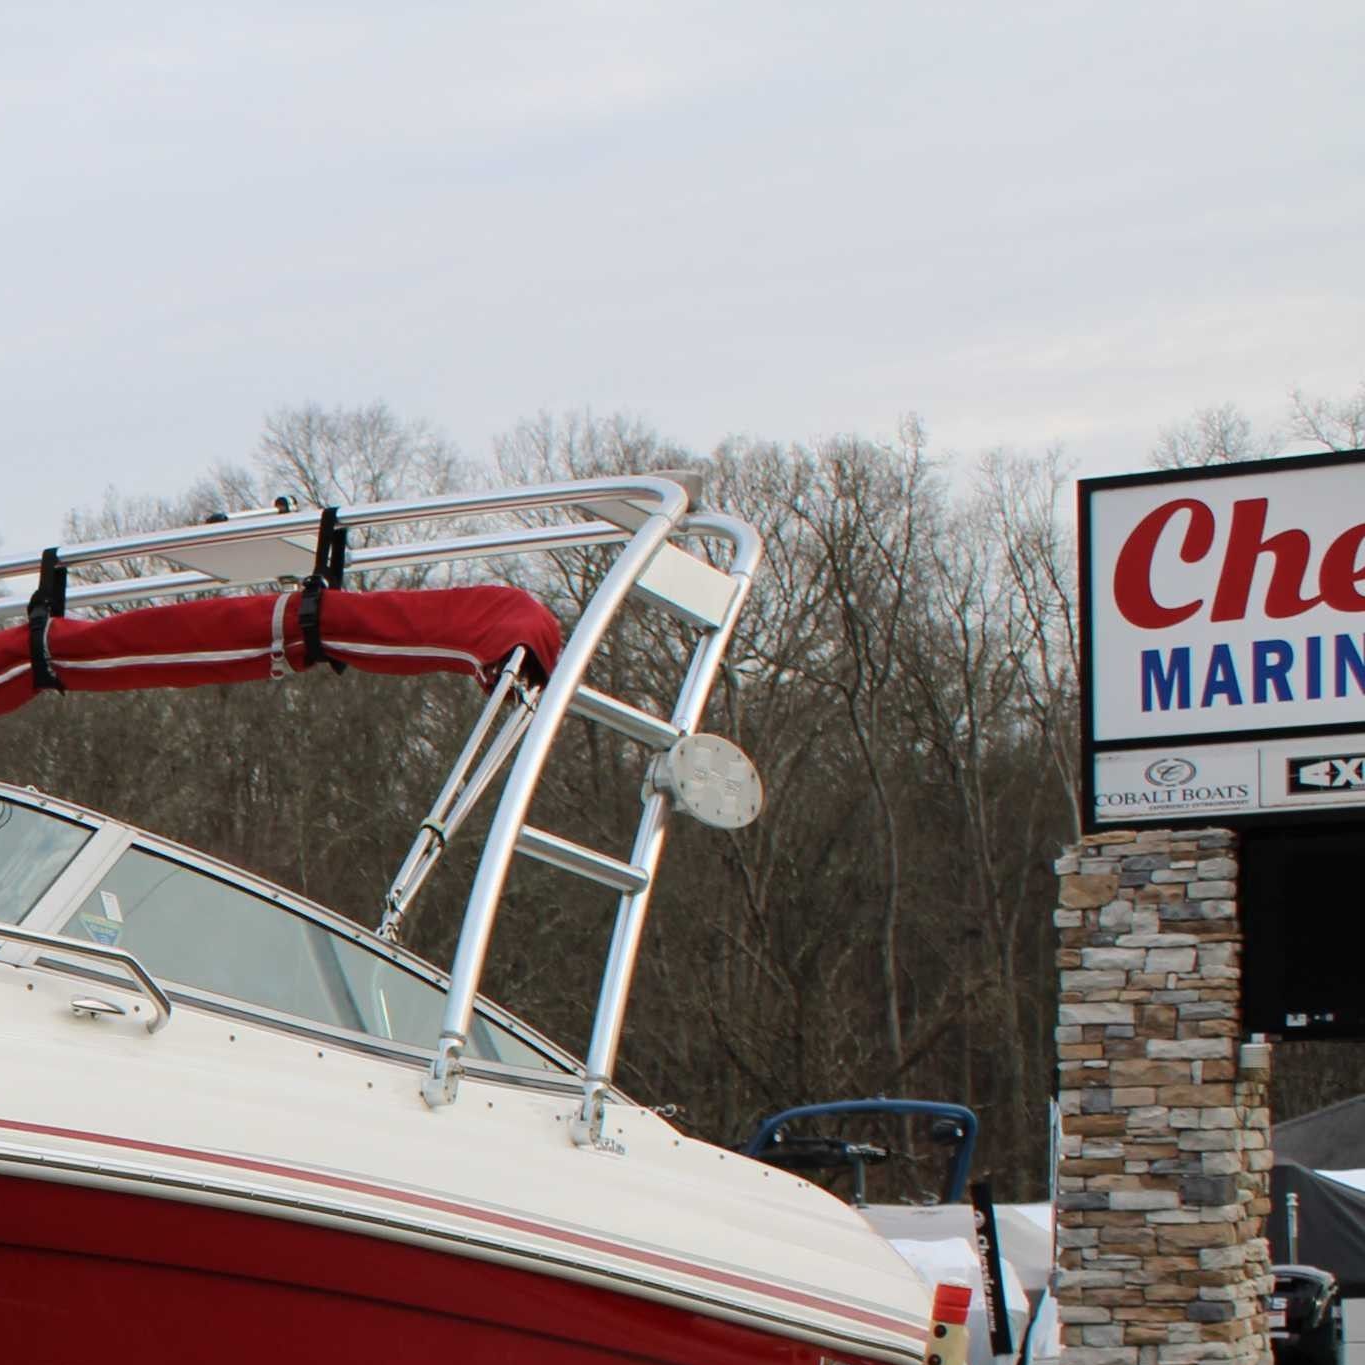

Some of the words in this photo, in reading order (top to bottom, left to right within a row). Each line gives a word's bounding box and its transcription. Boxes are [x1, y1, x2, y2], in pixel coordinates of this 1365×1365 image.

[1113, 496, 1365, 630] Che
[1140, 632, 1365, 713] MARIN
[1094, 789, 1177, 808] COBALT
[1182, 784, 1249, 802] BOATS
